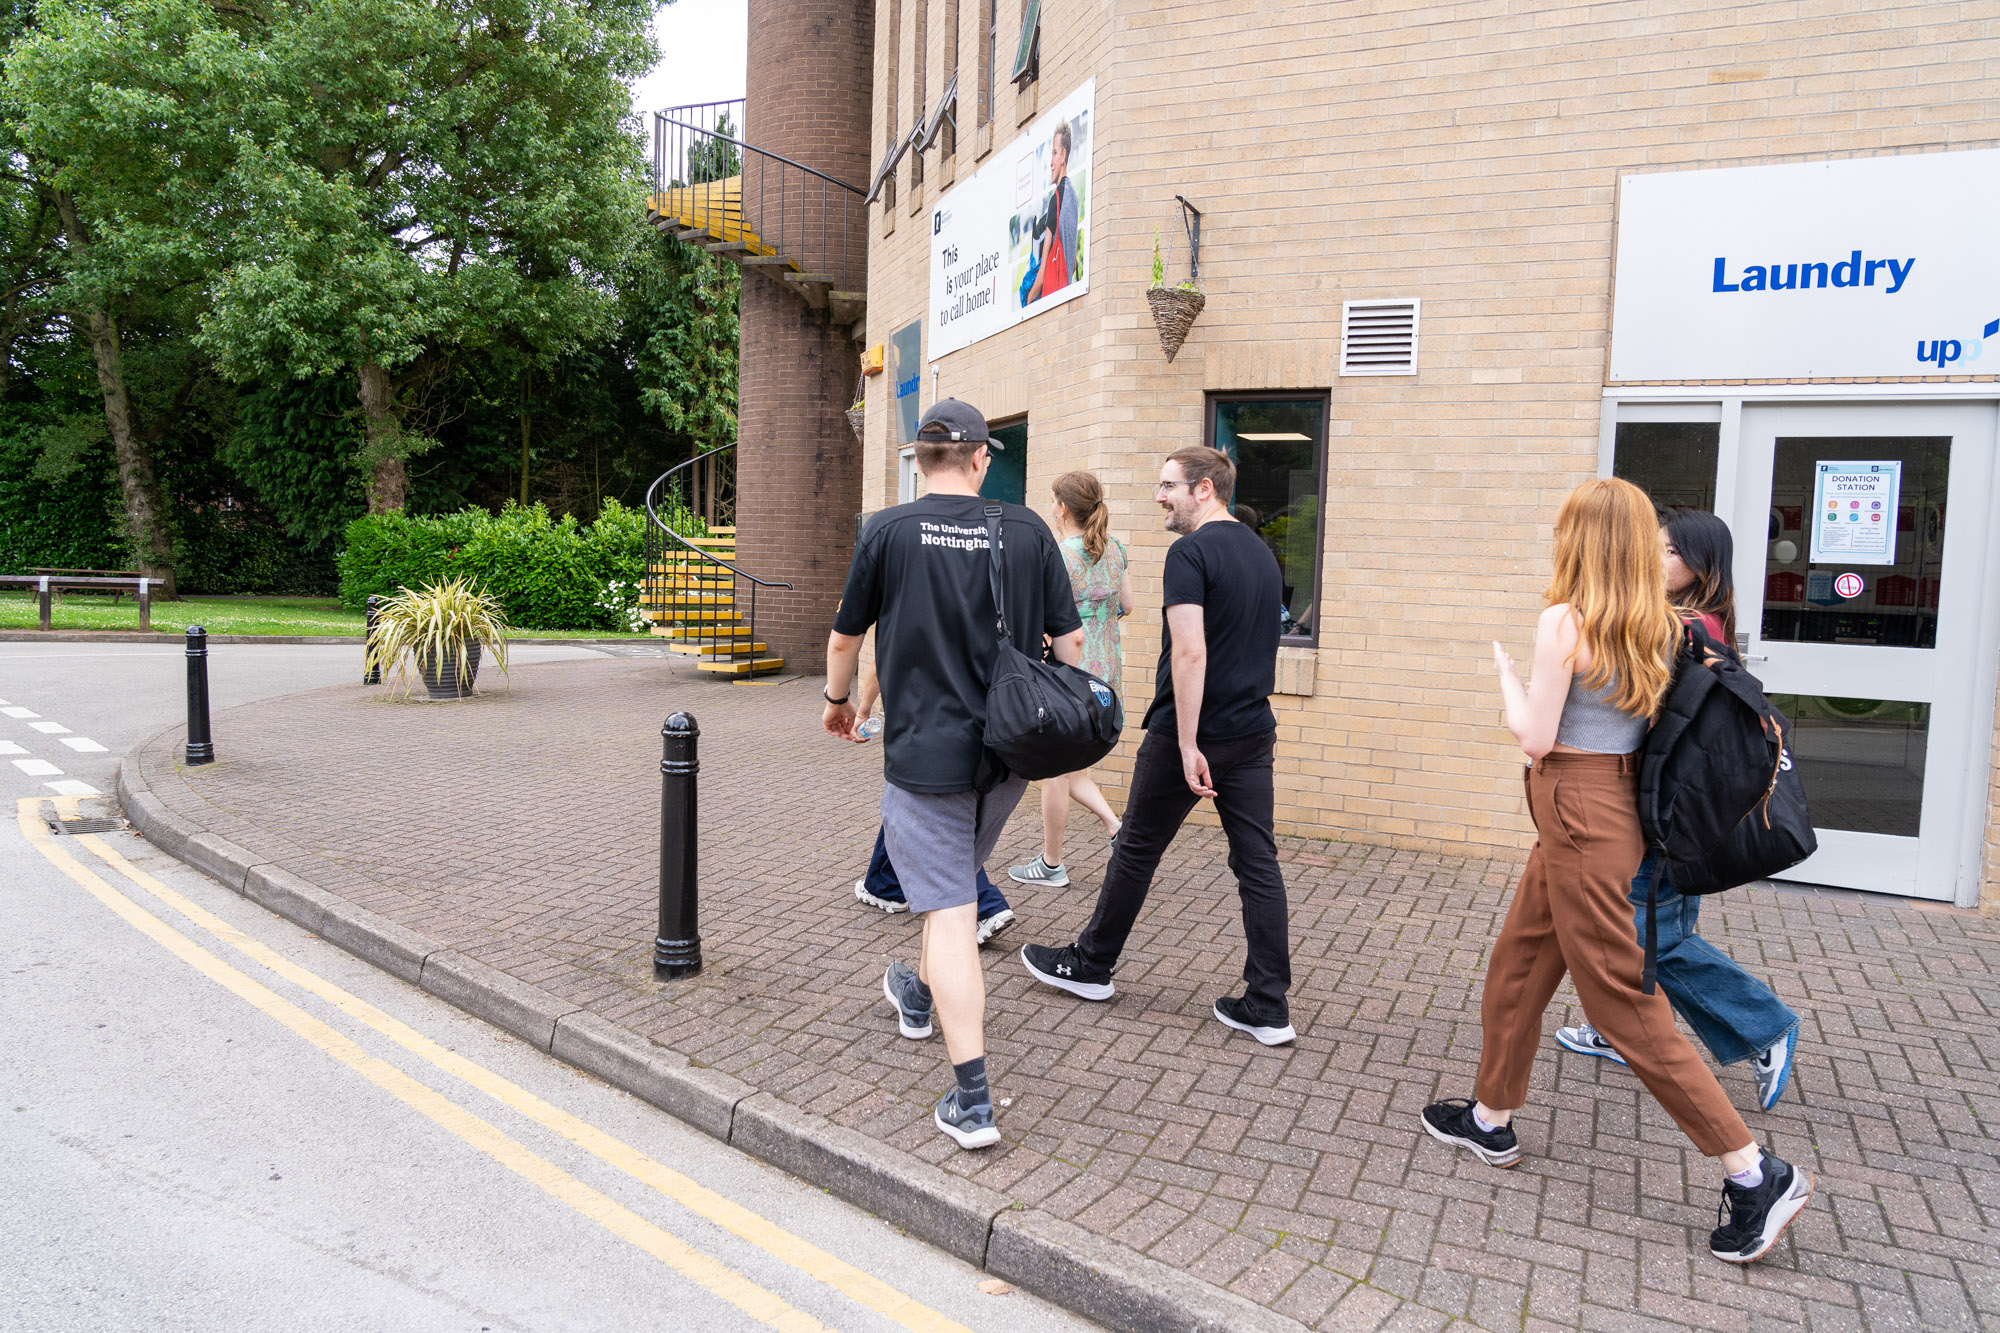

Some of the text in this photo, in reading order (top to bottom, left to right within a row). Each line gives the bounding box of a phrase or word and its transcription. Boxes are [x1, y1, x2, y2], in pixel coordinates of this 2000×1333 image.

[942, 243, 958, 269] This
[946, 251, 999, 298] is your place
[1712, 250, 1916, 294] Laundry
[940, 287, 990, 326] to call home
[1837, 483, 1875, 491] STATION
[920, 522, 940, 532] The
[941, 524, 989, 537] University
[921, 533, 1003, 551] Nottingha
